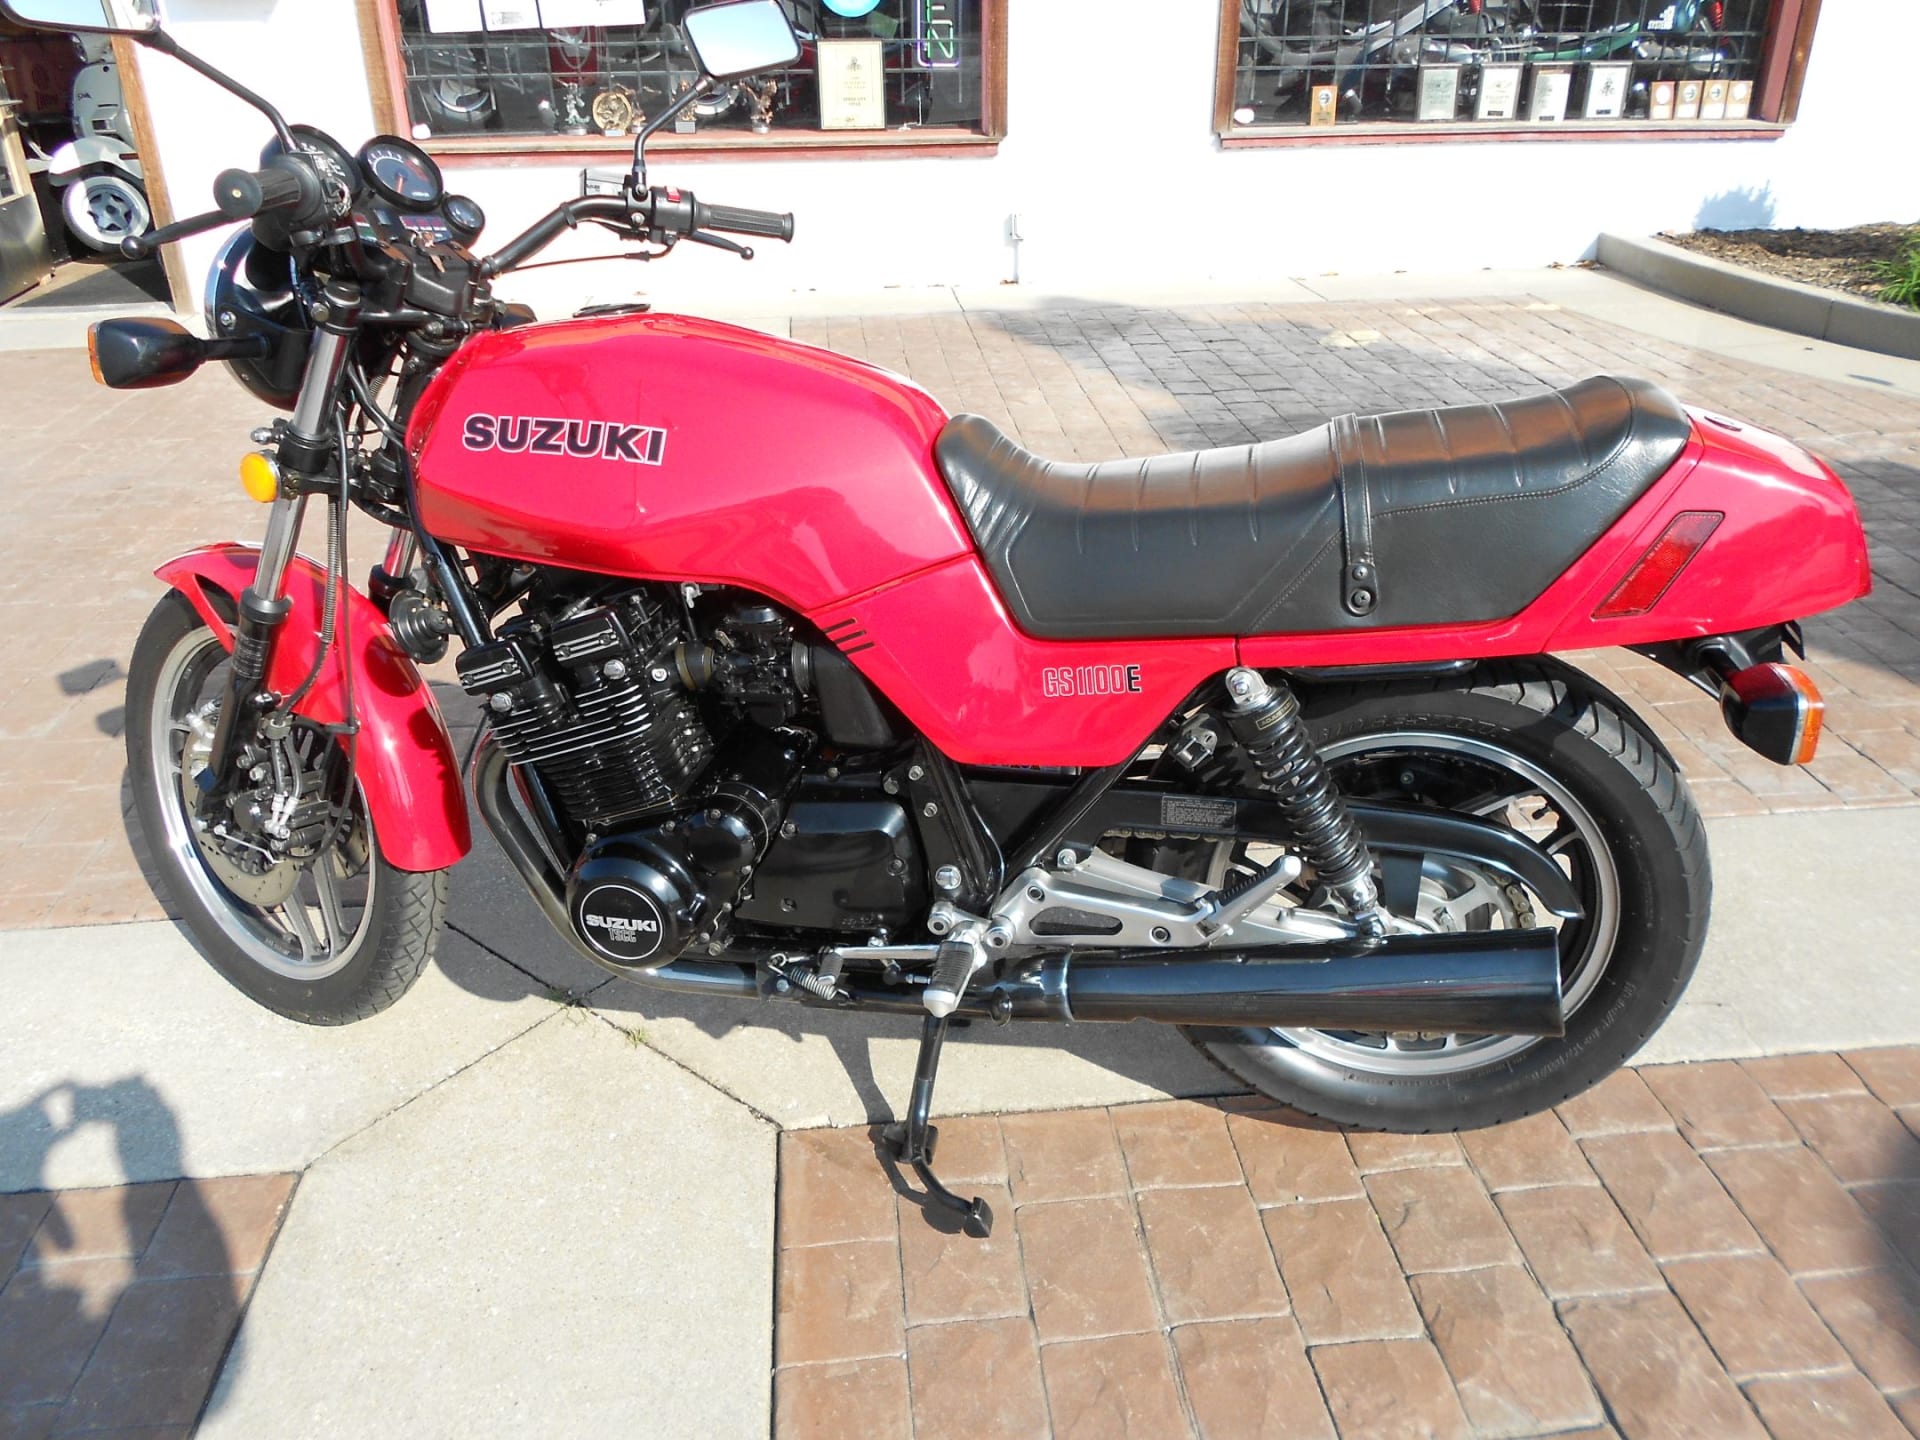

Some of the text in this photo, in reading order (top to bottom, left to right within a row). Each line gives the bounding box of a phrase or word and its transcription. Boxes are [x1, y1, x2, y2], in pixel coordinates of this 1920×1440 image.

[462, 412, 667, 466] SUZUKI
[1043, 664, 1142, 697] GS1100E
[585, 914, 657, 932] SUZUKI
